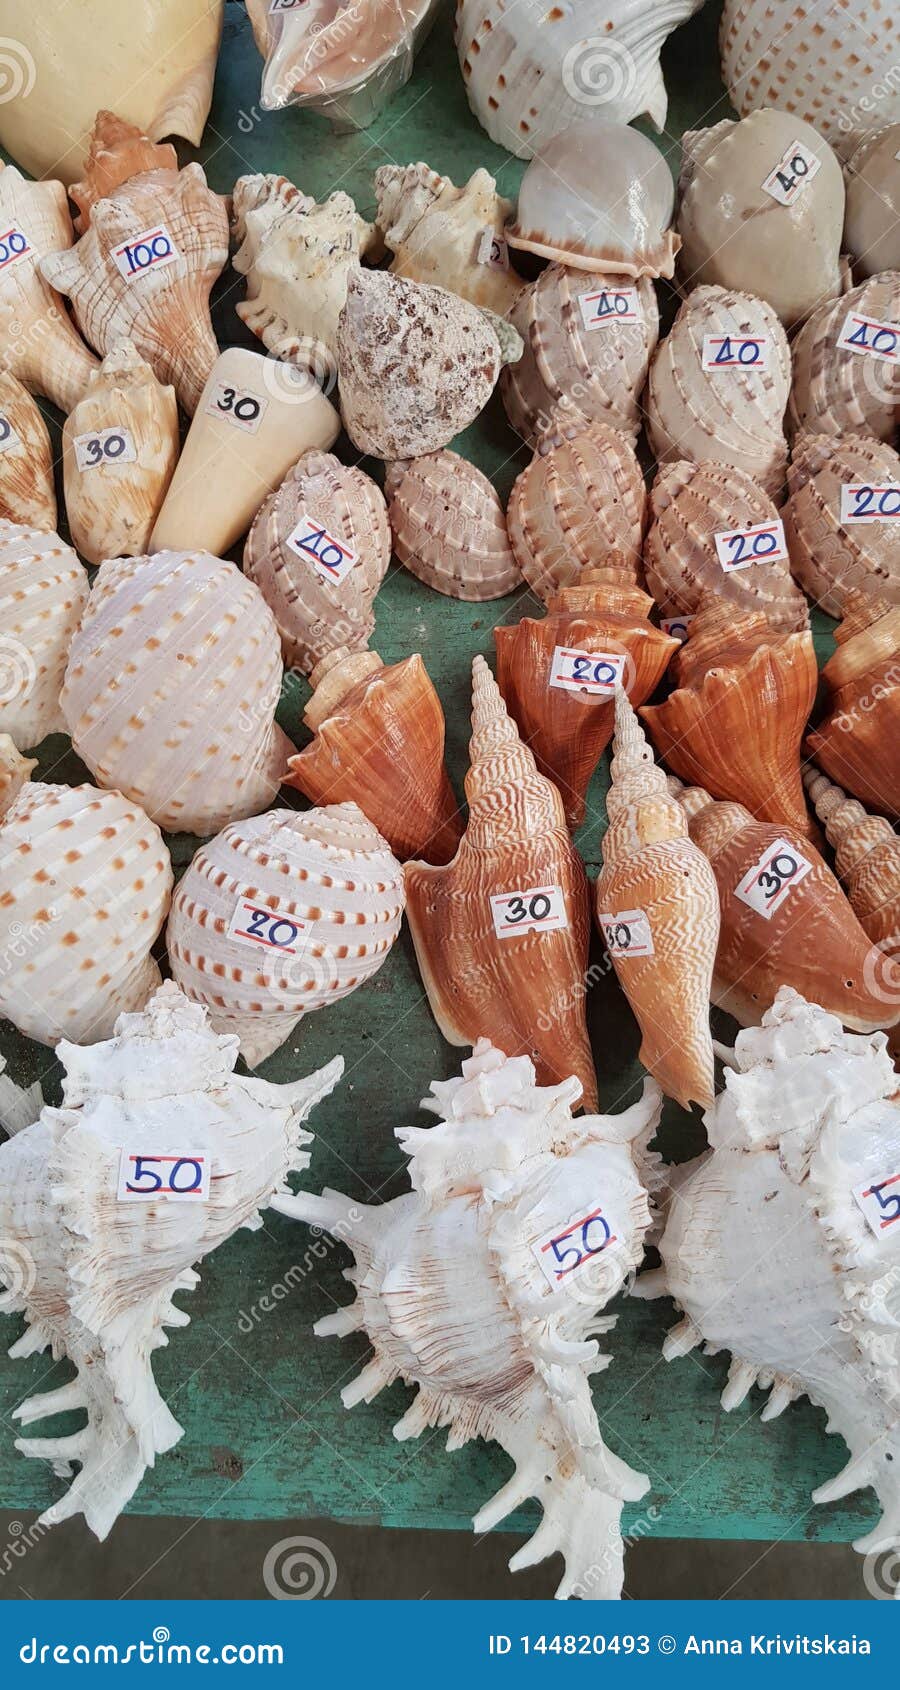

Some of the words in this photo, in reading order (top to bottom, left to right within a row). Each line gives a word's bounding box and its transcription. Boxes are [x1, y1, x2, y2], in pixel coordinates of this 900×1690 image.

[774, 154, 809, 193] 40
[124, 236, 171, 273] 100
[597, 291, 628, 316] 40
[714, 337, 760, 365] 40
[848, 322, 898, 353] 40
[217, 388, 260, 421] 30
[86, 435, 126, 466] 30
[853, 486, 900, 517] 20
[295, 530, 343, 568] 40
[728, 533, 777, 566] 20
[572, 657, 616, 684] 20
[758, 854, 798, 899] 30
[505, 894, 552, 923] 30
[247, 909, 298, 947] 20
[606, 923, 631, 948] 30
[126, 1156, 203, 1194] 50
[550, 1216, 610, 1274] 50
